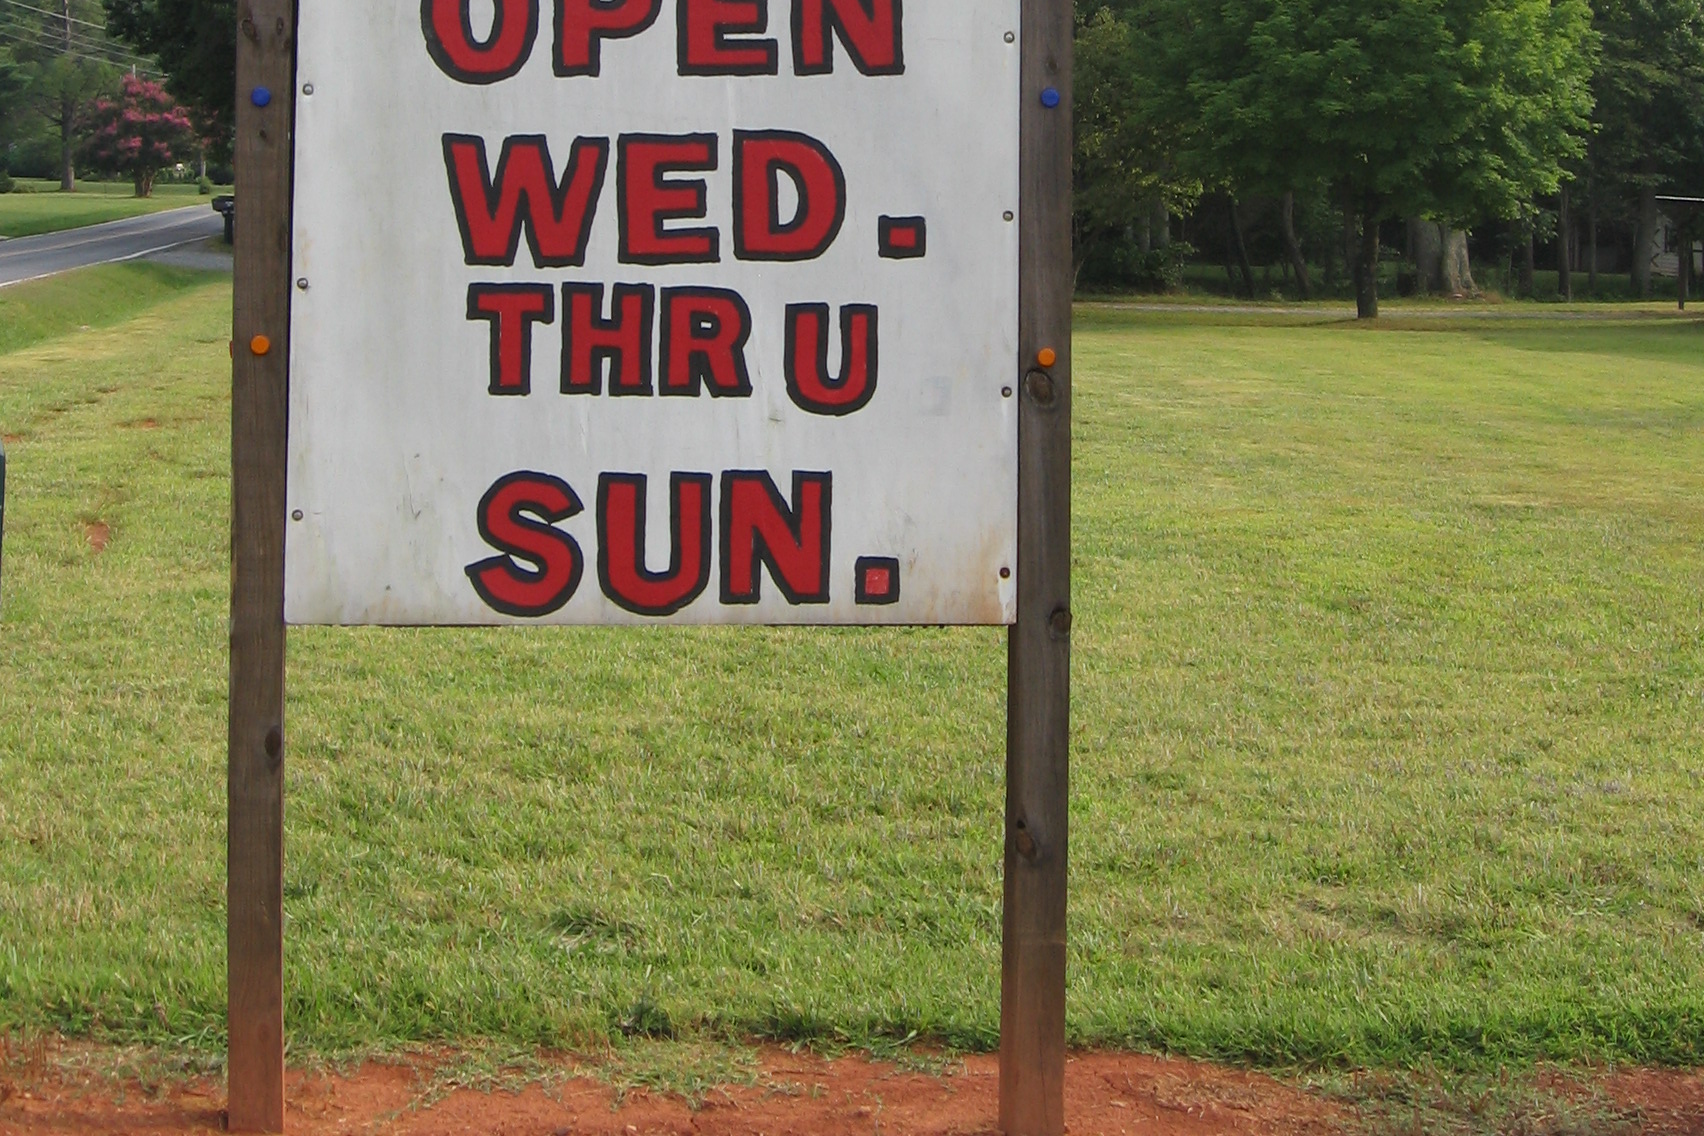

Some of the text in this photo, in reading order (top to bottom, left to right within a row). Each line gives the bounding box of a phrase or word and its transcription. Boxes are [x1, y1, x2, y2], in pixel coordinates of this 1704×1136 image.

[441, 129, 927, 270] WED.
[466, 282, 879, 418] THRU
[464, 469, 901, 619] SUN.
